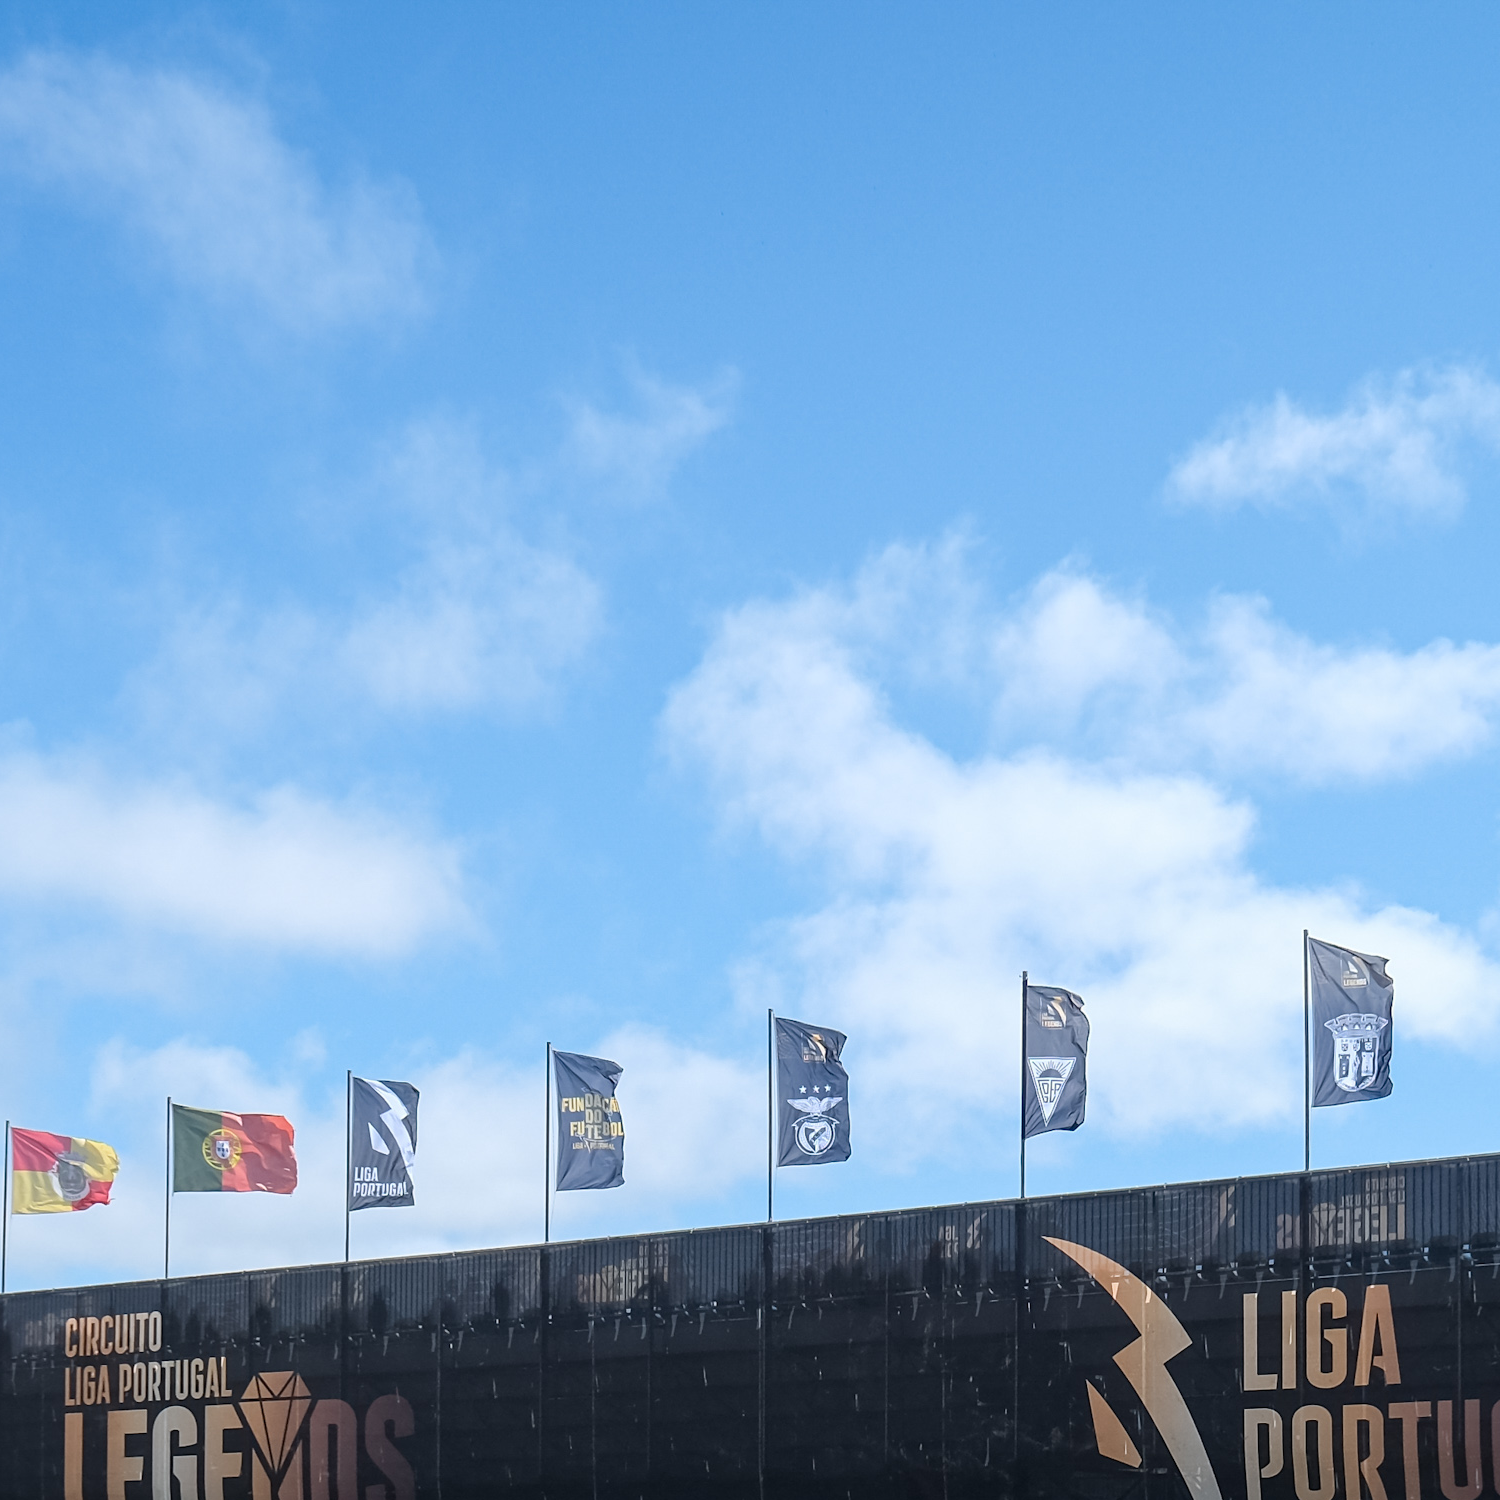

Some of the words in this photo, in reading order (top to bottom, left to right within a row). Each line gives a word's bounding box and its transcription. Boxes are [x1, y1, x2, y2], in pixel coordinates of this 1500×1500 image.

[585, 1109, 602, 1124] DO
[570, 1120, 624, 1140] FUTEBOL
[354, 1166, 378, 1182] LIGA
[353, 1182, 409, 1197] PORTUGAL
[65, 1311, 163, 1357] CIRCUITO
[1243, 1284, 1401, 1391] LIGA
[64, 1365, 111, 1406] LIGA
[119, 1357, 232, 1403] PORTUGAL
